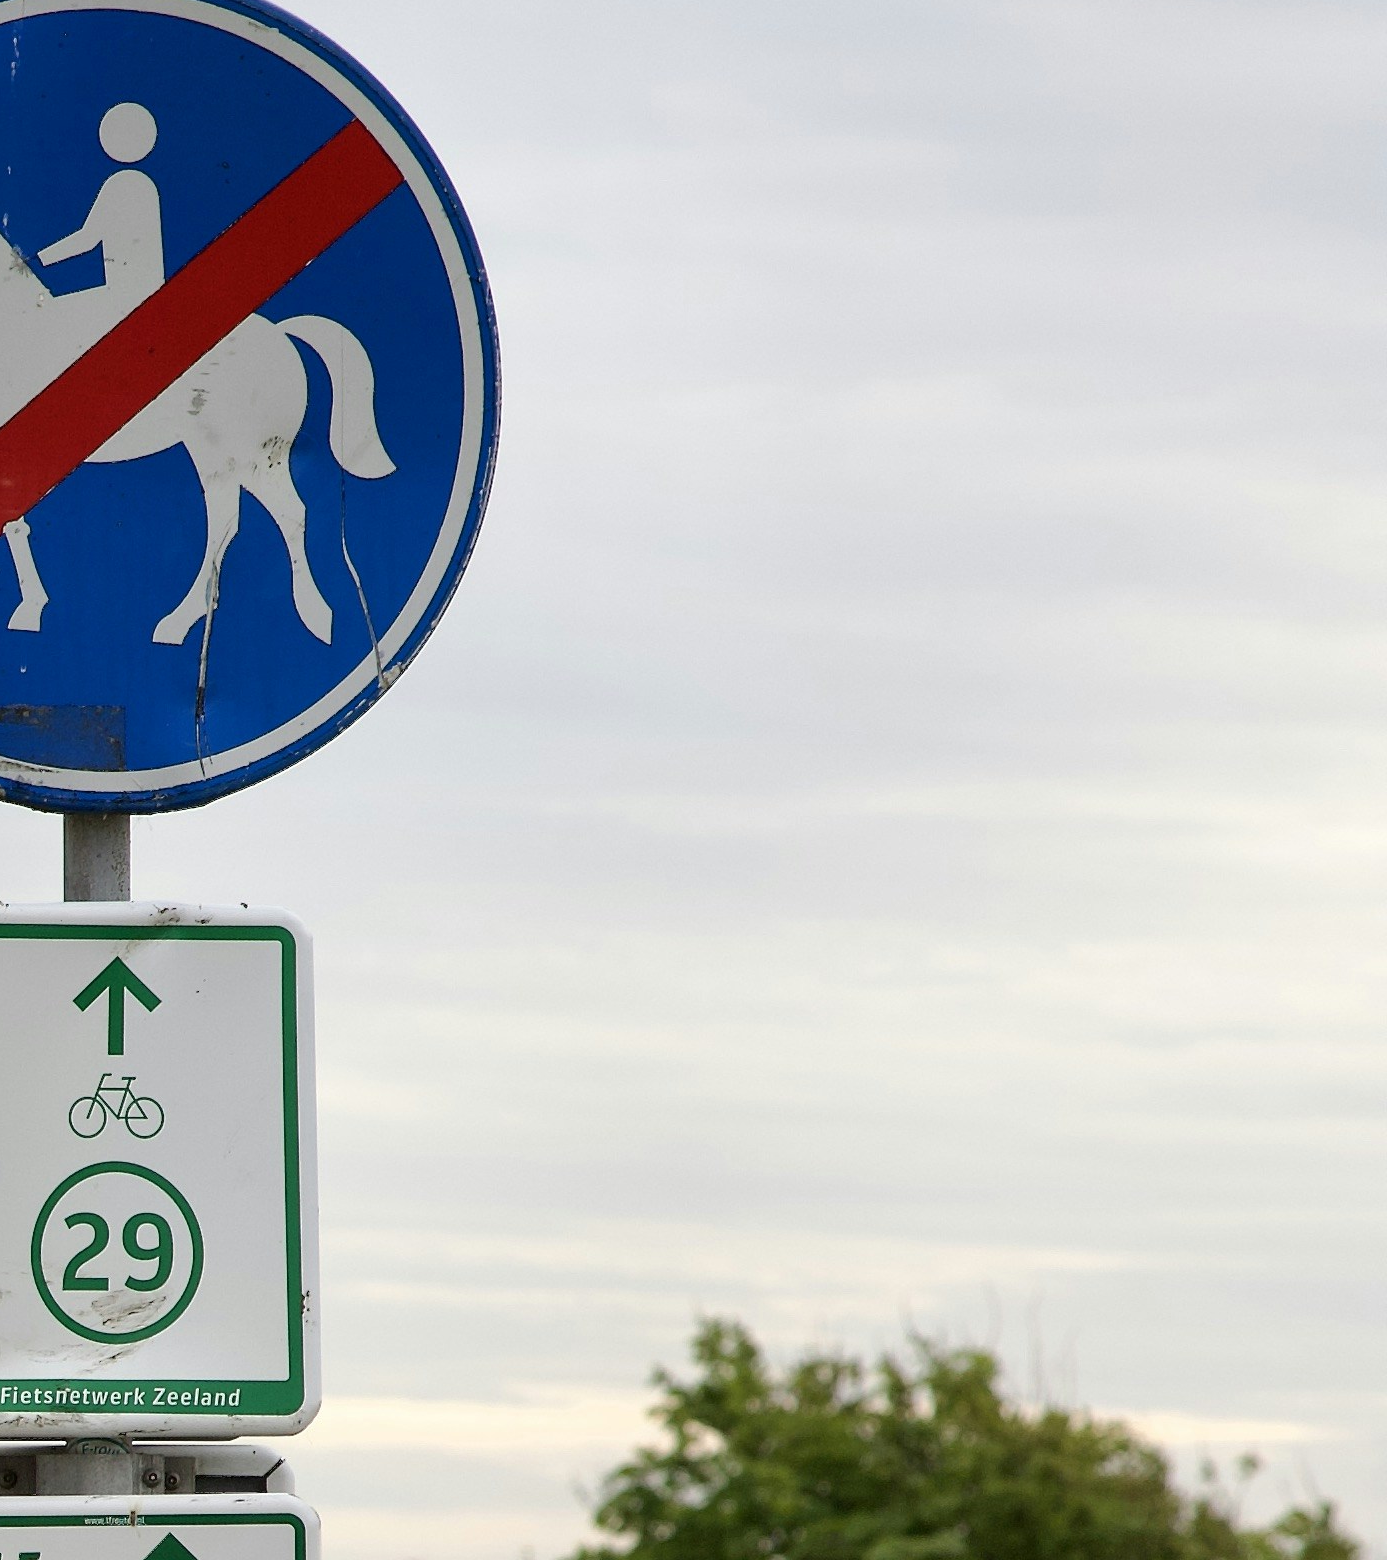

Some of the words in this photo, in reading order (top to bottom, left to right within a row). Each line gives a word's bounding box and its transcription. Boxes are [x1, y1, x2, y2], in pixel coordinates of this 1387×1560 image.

[62, 1212, 174, 1292] 29
[0, 1387, 146, 1406] Fietsnetwerk
[152, 1388, 241, 1407] Zeeland
